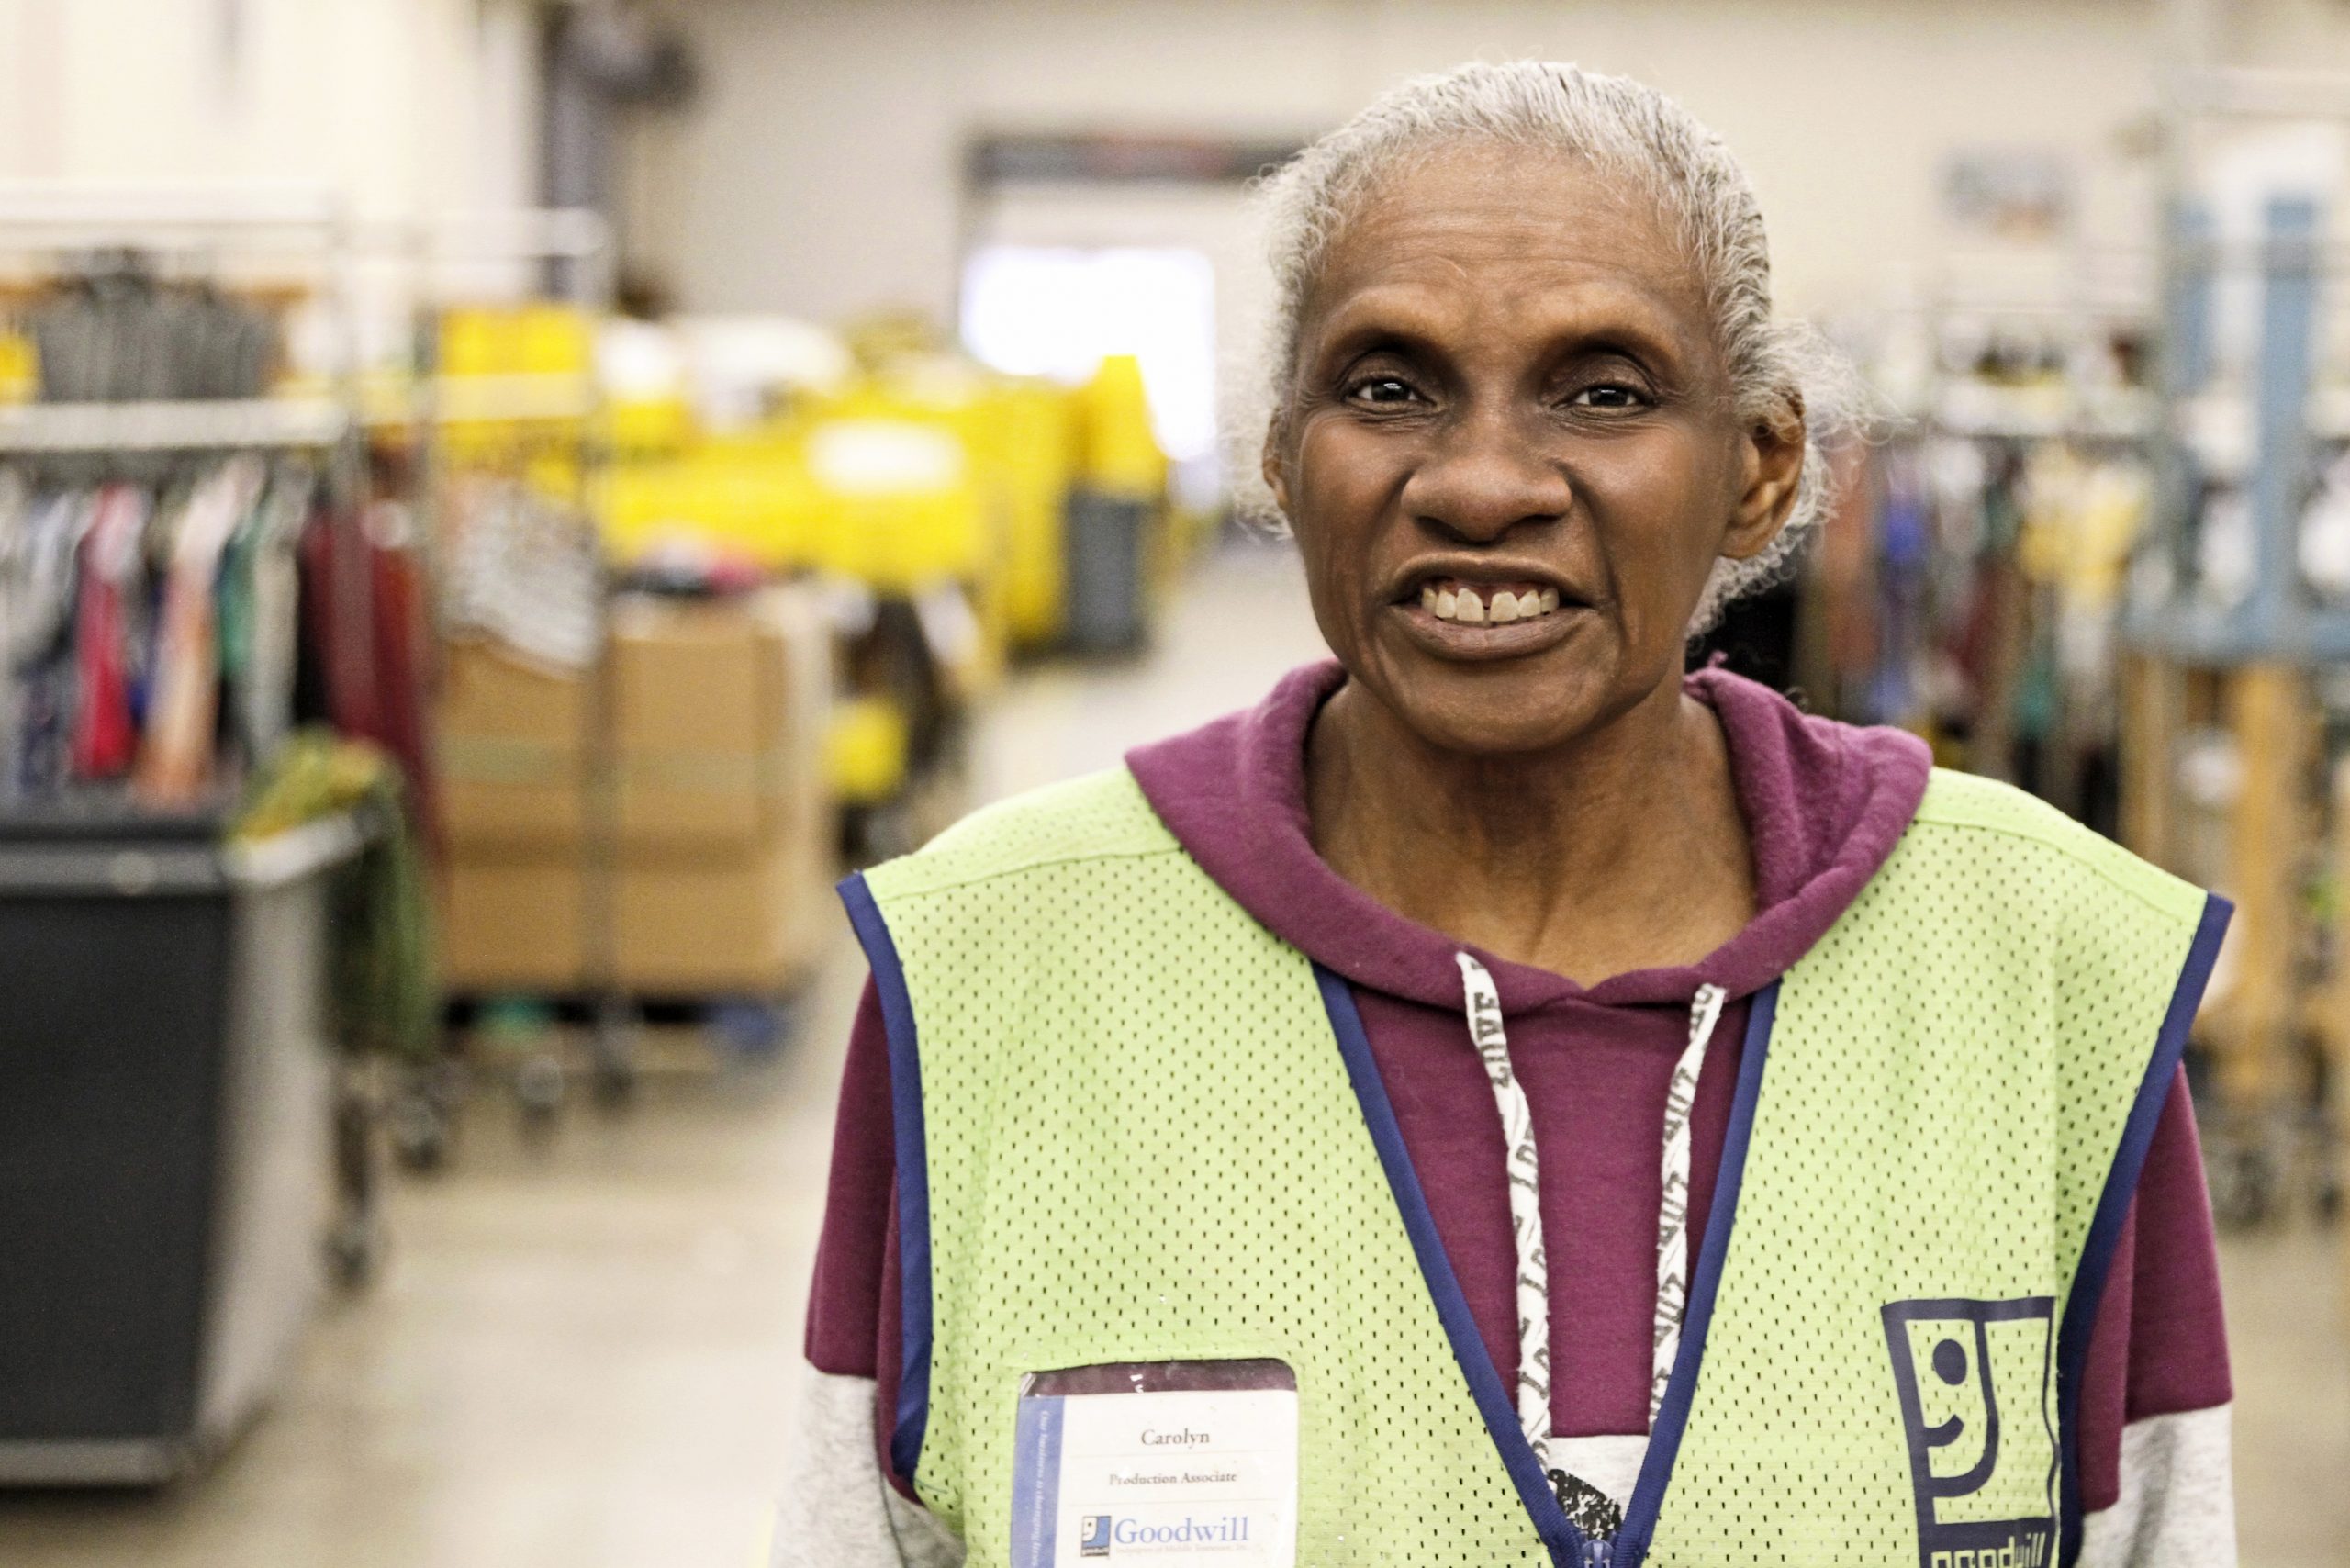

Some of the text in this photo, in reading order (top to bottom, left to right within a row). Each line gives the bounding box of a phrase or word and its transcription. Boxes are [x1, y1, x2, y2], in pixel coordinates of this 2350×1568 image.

[1141, 1428, 1211, 1450] Carolyn
[1109, 1471, 1237, 1486] Production Associate
[1114, 1516, 1249, 1545] Goodwill
